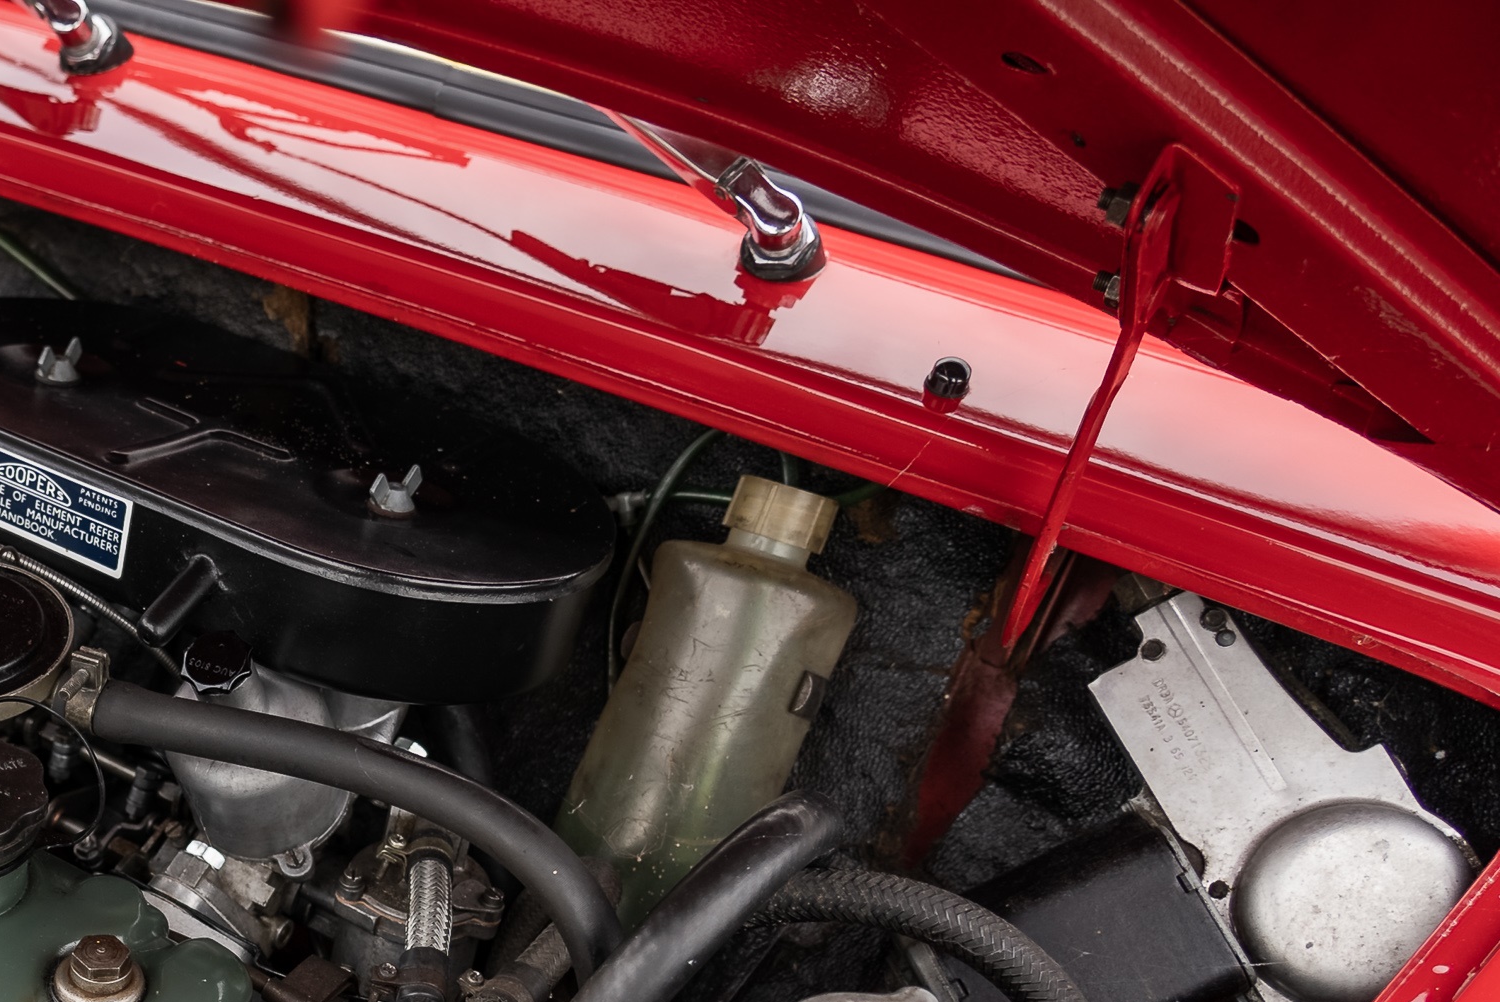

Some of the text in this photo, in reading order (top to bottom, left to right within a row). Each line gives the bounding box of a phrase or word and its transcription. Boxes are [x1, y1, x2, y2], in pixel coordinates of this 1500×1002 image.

[78, 497, 117, 518] PENDING
[80, 488, 118, 509] PATENTS
[12, 490, 27, 503] OF
[35, 500, 82, 527] ELEMENT
[89, 523, 119, 543] REFER
[27, 508, 118, 555] MANUFACTURERS
[213, 665, 236, 677] AUC
